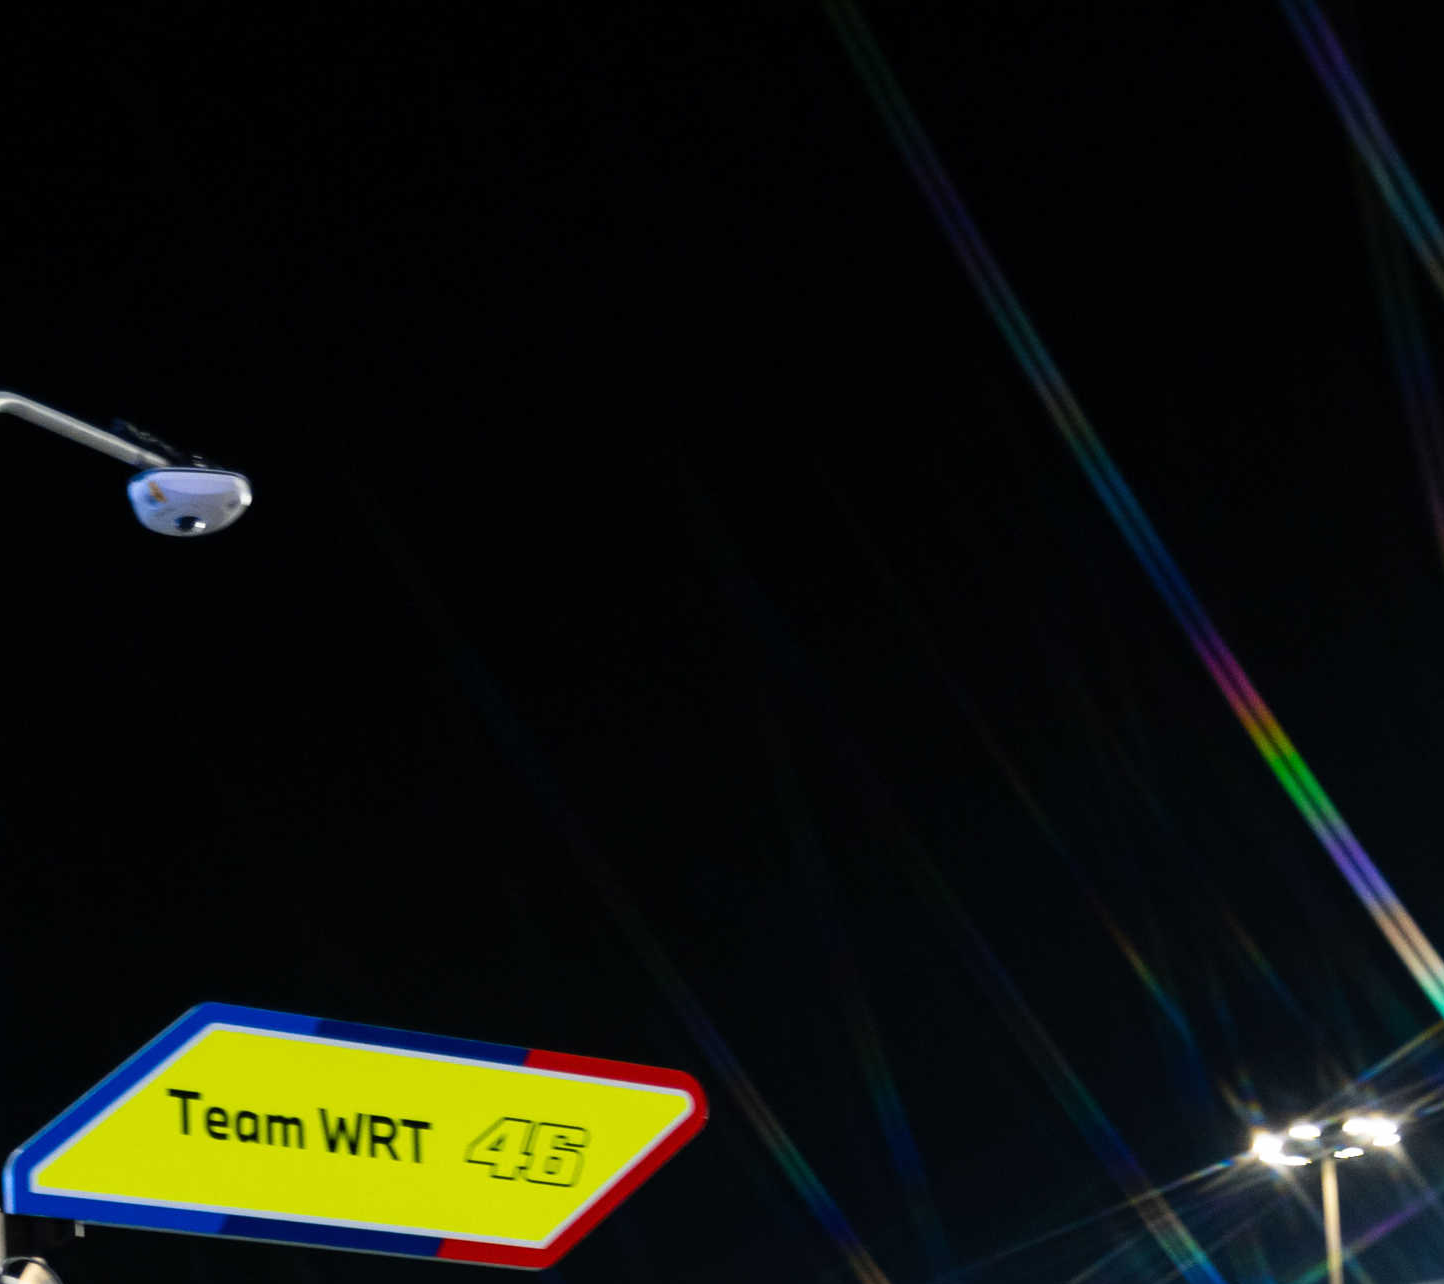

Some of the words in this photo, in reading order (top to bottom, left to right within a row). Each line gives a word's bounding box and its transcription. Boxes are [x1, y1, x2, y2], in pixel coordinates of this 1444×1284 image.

[167, 1087, 307, 1150] Team
[318, 1107, 434, 1165] WRT
[465, 1116, 590, 1188] 46
